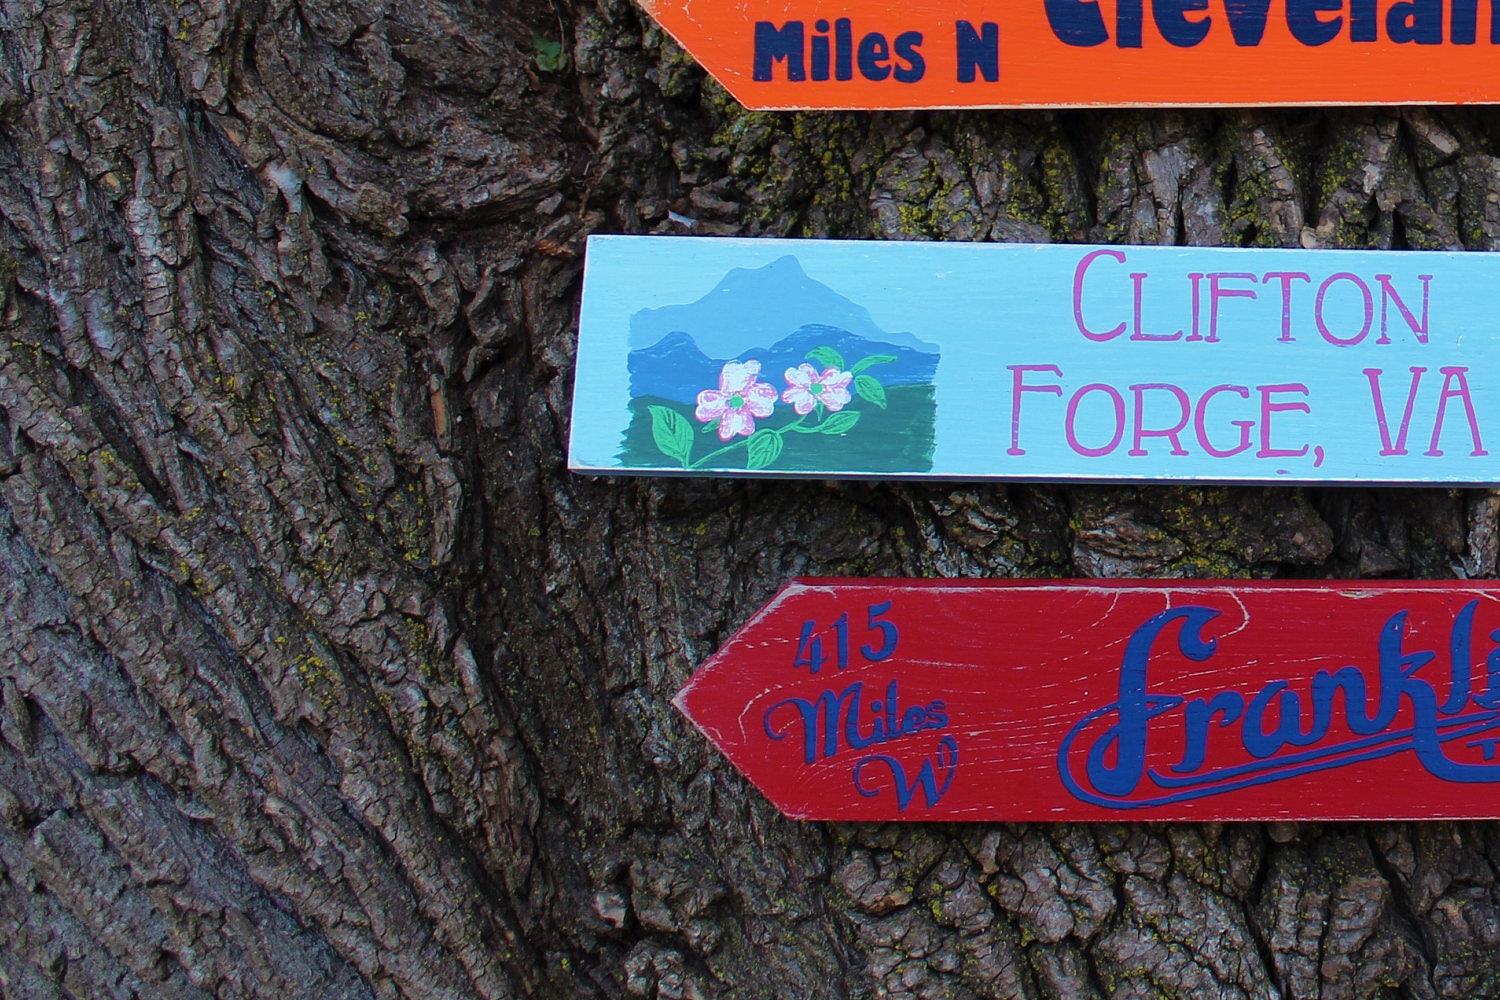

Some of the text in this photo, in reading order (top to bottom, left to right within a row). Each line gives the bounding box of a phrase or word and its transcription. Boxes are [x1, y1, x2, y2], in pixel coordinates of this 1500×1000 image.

[752, 17, 999, 84] Miles N
[1072, 249, 1434, 348] CLIFTON
[1006, 364, 1489, 468] FORGE, VA
[793, 600, 899, 674] 415
[763, 680, 950, 765] Miles
[853, 735, 959, 813] W
